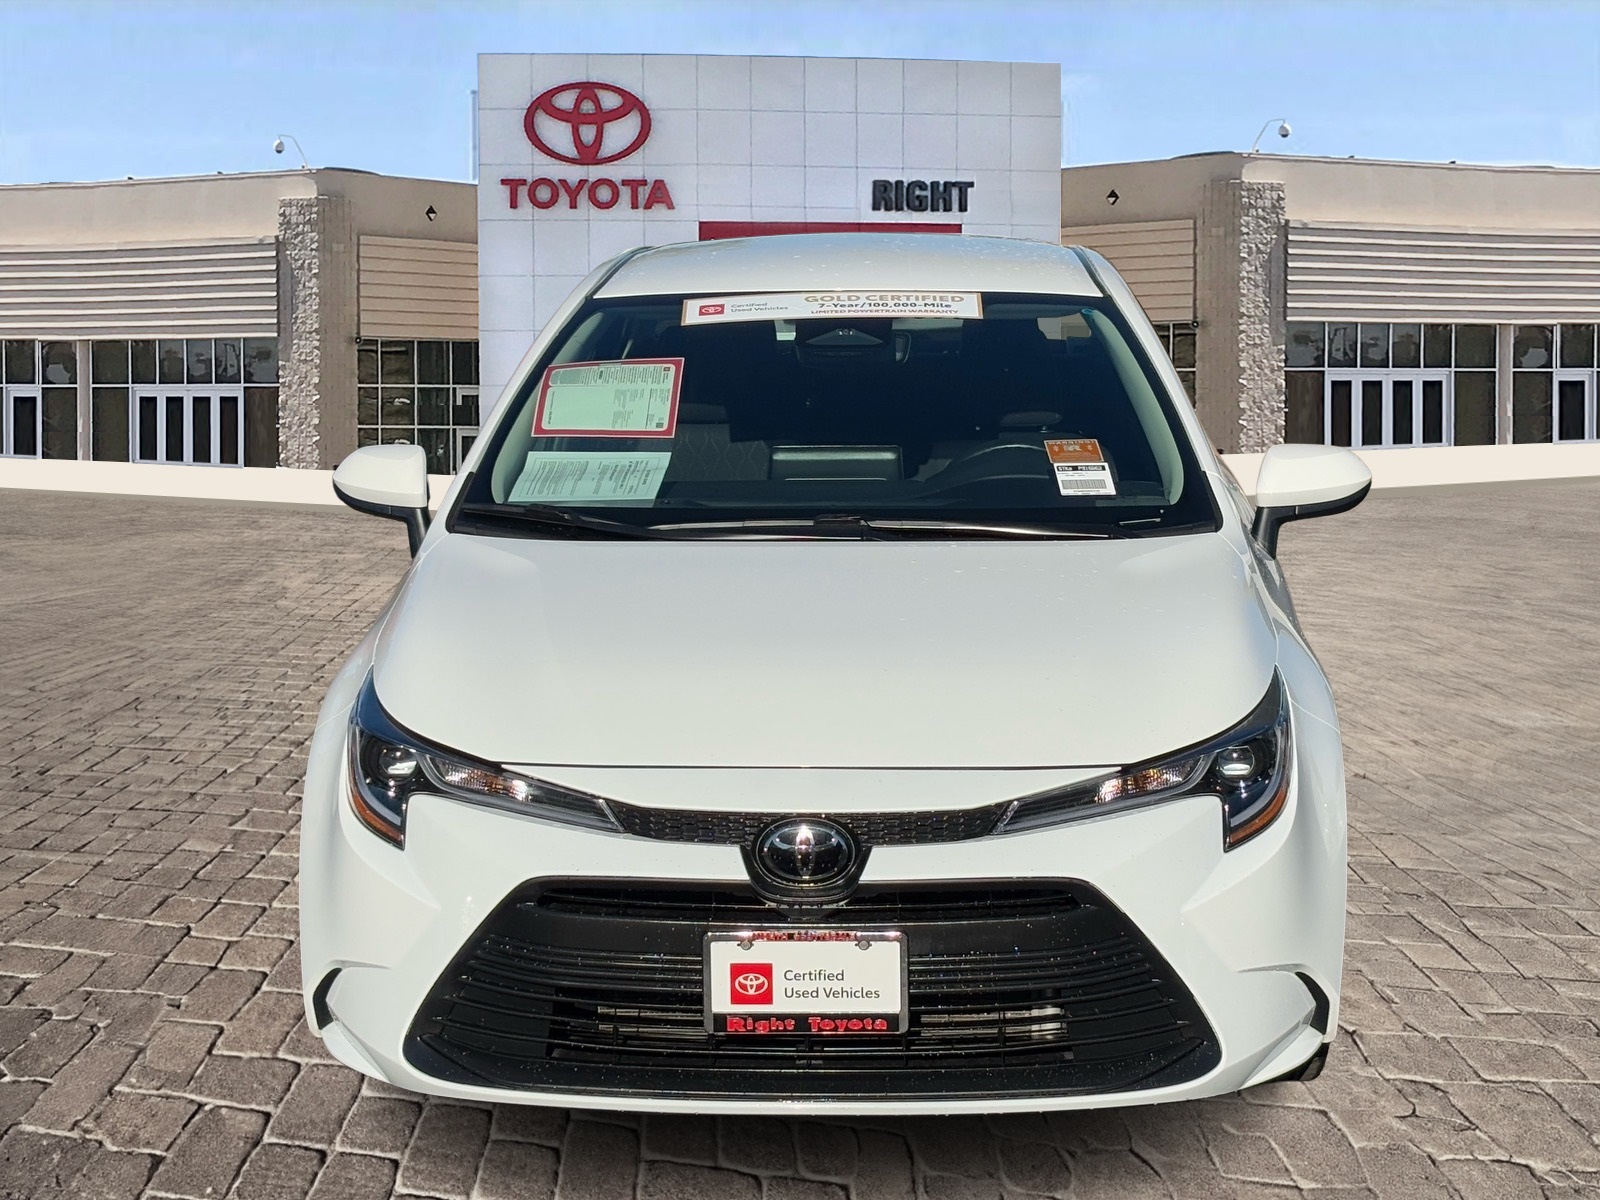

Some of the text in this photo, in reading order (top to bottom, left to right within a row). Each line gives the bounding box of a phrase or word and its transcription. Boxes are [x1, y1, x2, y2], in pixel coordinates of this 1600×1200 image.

[500, 178, 675, 210] TOYOTA
[872, 180, 975, 212] RIGHT
[804, 294, 965, 303] GOLD CERTIFIED
[784, 969, 845, 982] Certified
[784, 986, 881, 999] Used Vehicles
[726, 1015, 888, 1033] Right Toyota
